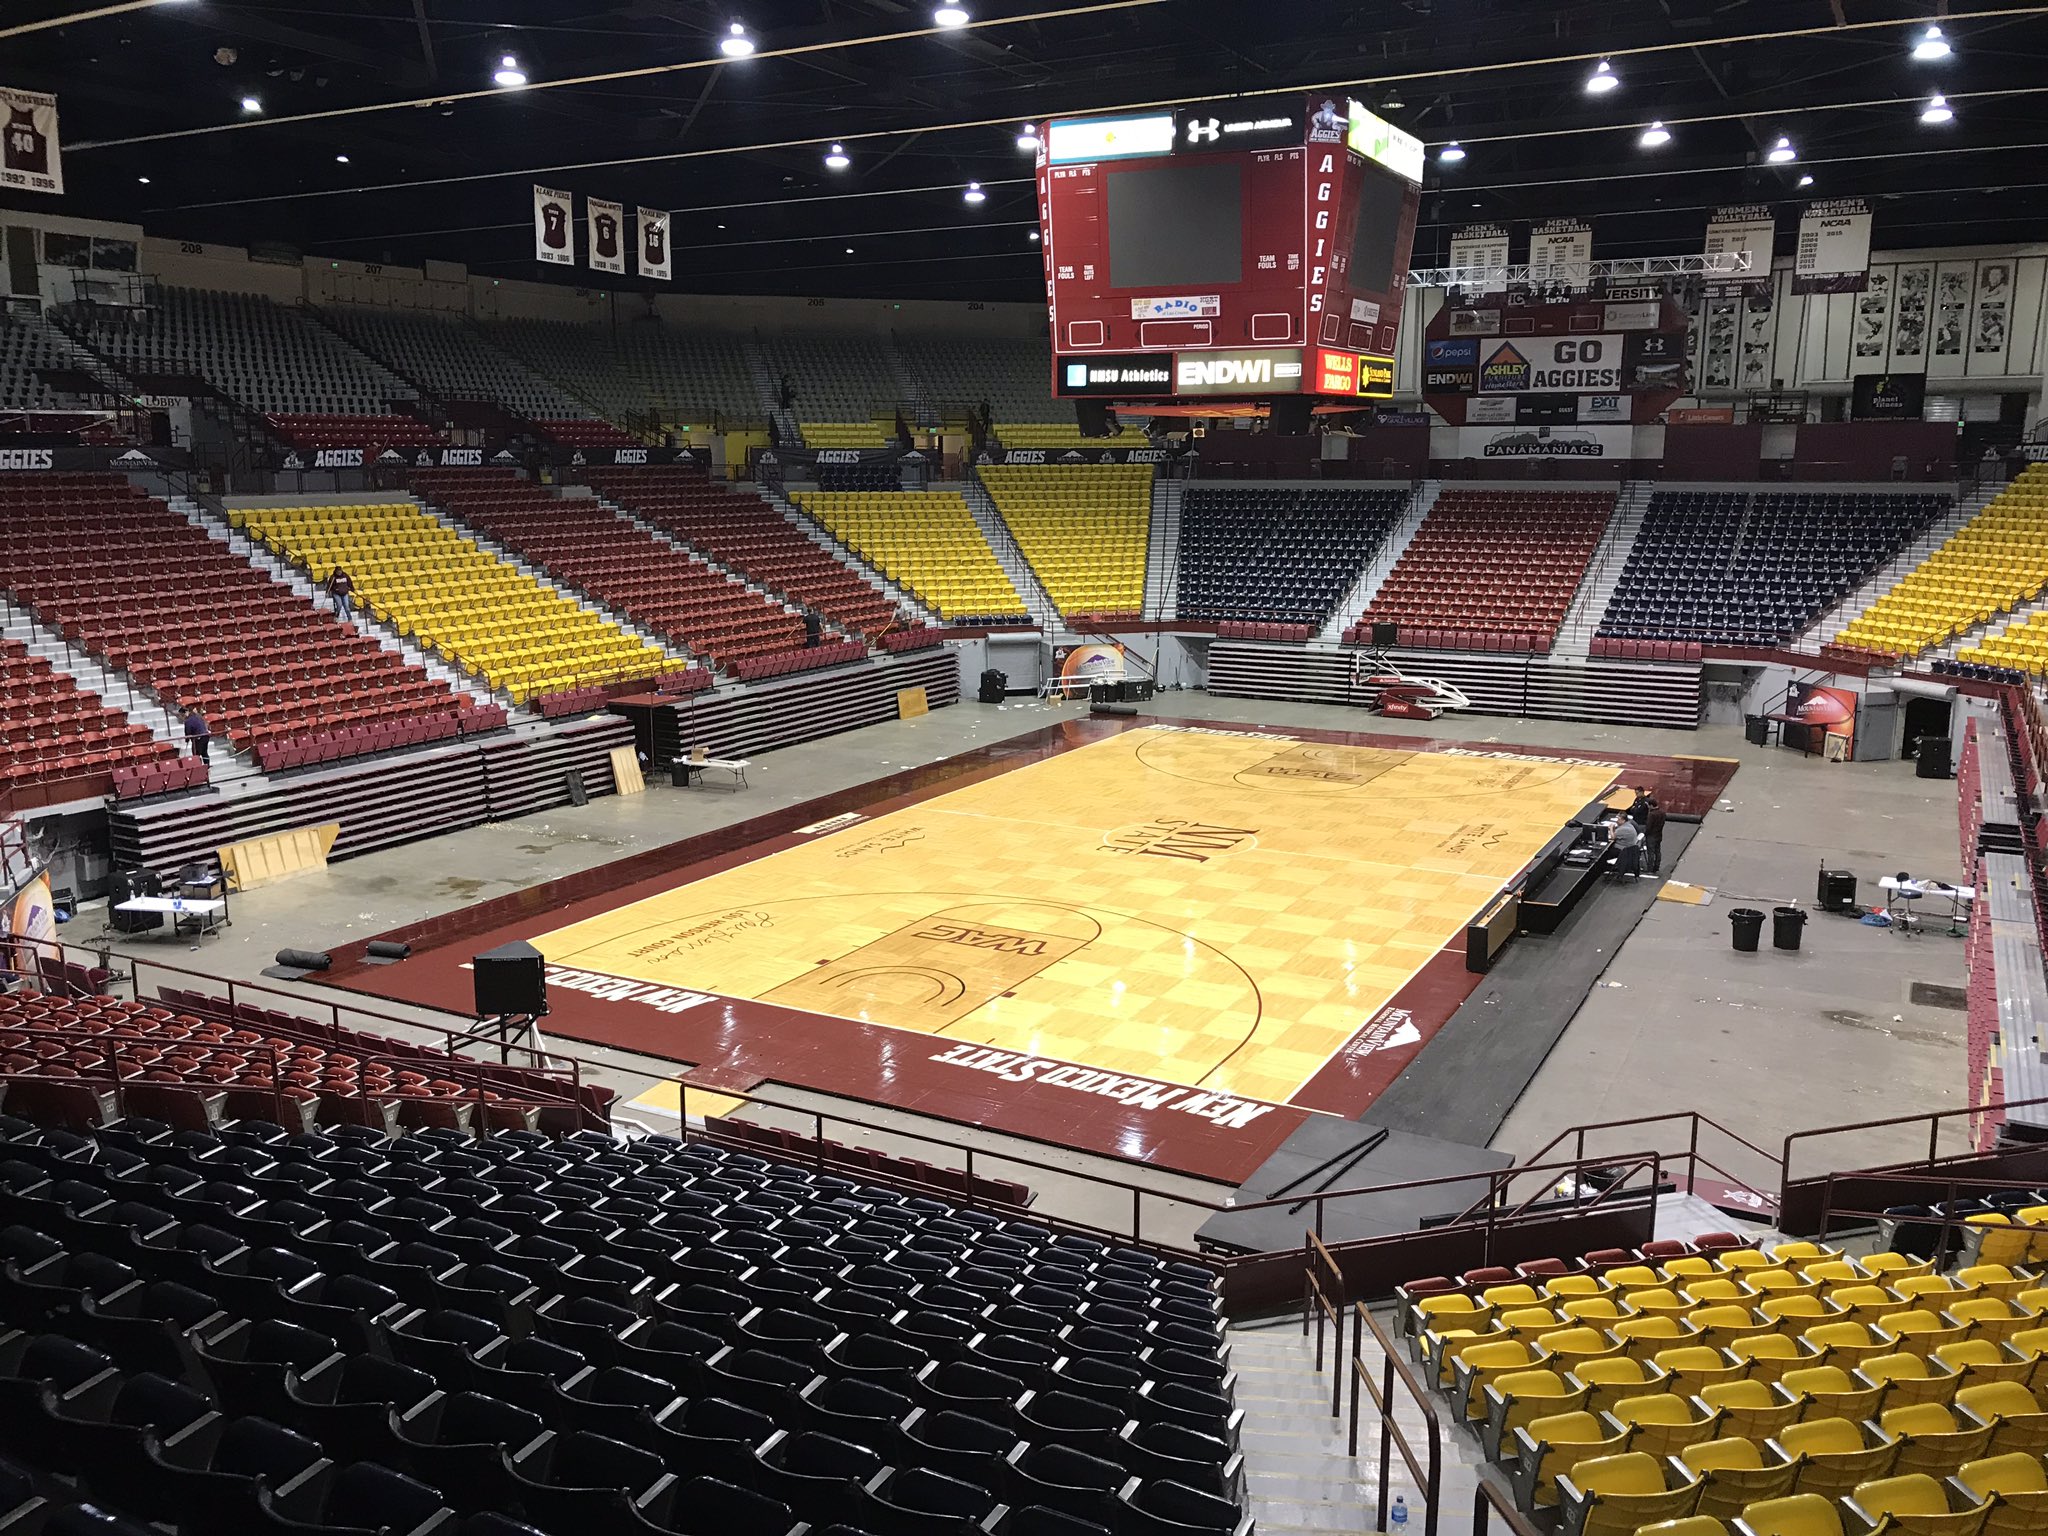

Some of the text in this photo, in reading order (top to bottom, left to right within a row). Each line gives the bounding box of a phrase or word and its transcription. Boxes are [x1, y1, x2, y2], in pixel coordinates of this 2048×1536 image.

[1311, 127, 1340, 139] AGGIES
[11, 131, 34, 154] 40
[1290, 152, 1299, 160] PTS
[1717, 205, 1768, 215] WOMEN'S
[1811, 199, 1865, 209] WOMEN'S
[551, 216, 557, 230] 7
[1547, 218, 1576, 227] MEN'S
[1711, 213, 1772, 223] VOLLEYBALL
[1820, 219, 1851, 227] NCAA
[603, 227, 609, 239] 6
[1310, 154, 1333, 312] AGGIES
[1452, 230, 1508, 239] BASKETBALL
[1532, 224, 1592, 234] BASKETBALL
[649, 234, 658, 247] 15
[1548, 236, 1574, 244] NCAA
[181, 242, 202, 254] 208
[365, 264, 383, 275] 207
[1604, 287, 1661, 300] VERSITY
[968, 303, 984, 311] 204
[1154, 300, 1197, 313] RADIO
[1445, 347, 1471, 358] pepsi
[1554, 340, 1603, 364] GO
[1324, 354, 1352, 372] WELLS
[1090, 369, 1169, 382] NMSU Athletics
[1178, 360, 1270, 385] ENDWI
[1484, 364, 1528, 376] ASHLEY
[1324, 374, 1351, 390] FARGO
[1427, 372, 1472, 385] ENDWI
[1533, 368, 1621, 388] AGGIES!
[146, 397, 181, 407] LOBBY
[1873, 396, 1898, 404] planet
[614, 449, 647, 464] AGGIES
[1004, 450, 1045, 463] AGGIES
[1126, 450, 1166, 463] AGGIES
[1486, 445, 1600, 456] PANAMANIACS
[2014, 445, 2048, 460] GGIE
[315, 449, 363, 467] AGGIES
[440, 449, 482, 466] AGGIES
[816, 451, 860, 464] AGGIES
[1387, 703, 1408, 712] xfinity
[1441, 748, 1626, 768] NEW MEXICO STATE
[1096, 818, 1188, 854] STATE
[1136, 822, 1260, 863] NM
[671, 919, 726, 940] HENSON
[910, 925, 1047, 956] WAC
[627, 939, 674, 957] COURT
[545, 970, 720, 1014] NEW MEXICO
[928, 1045, 1275, 1129] NEW MEXICO STATE
